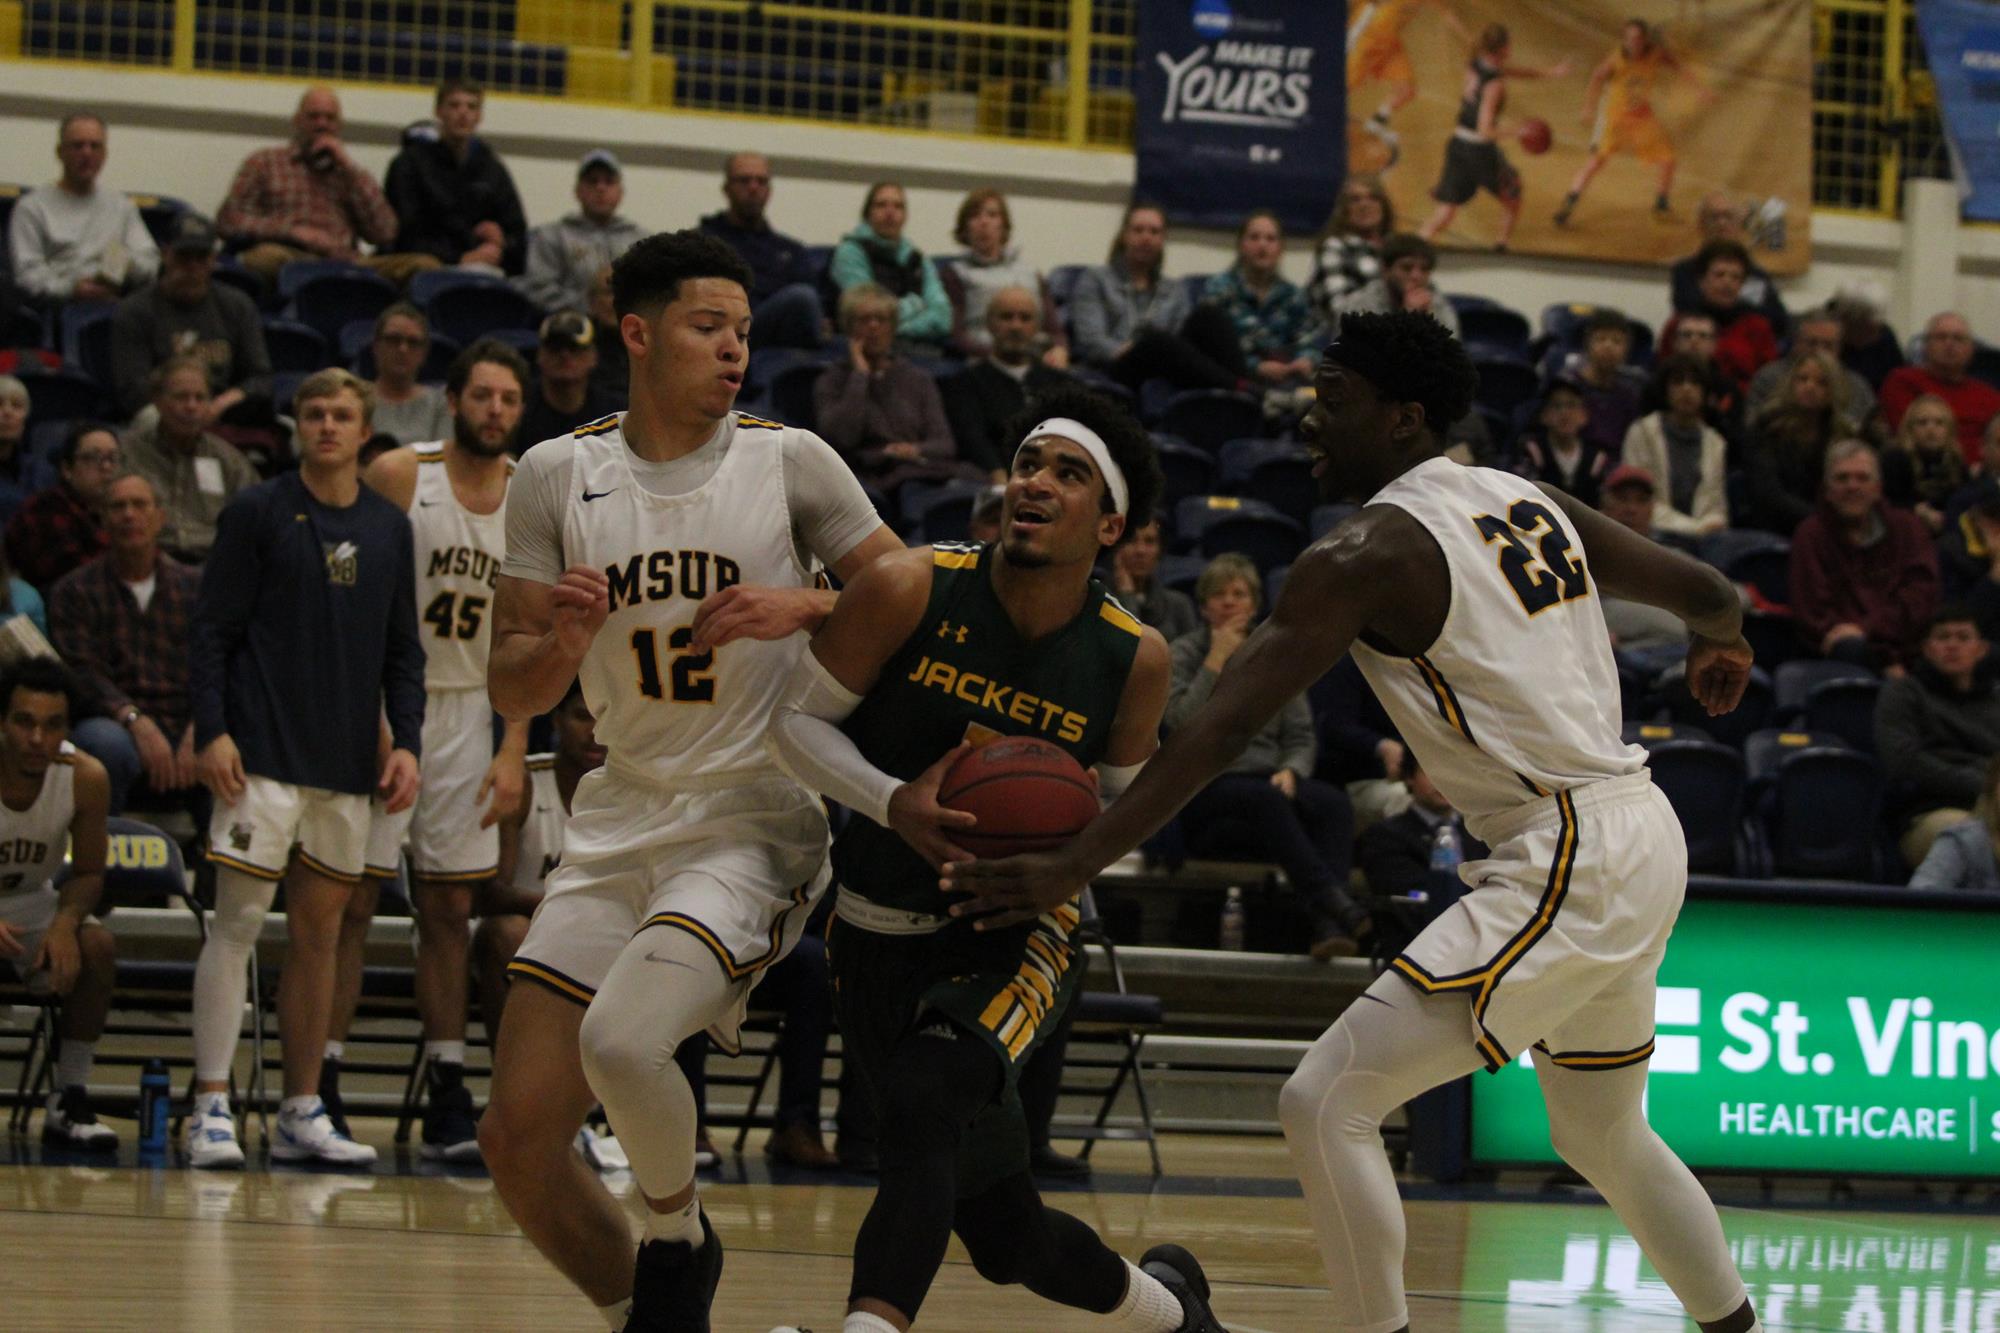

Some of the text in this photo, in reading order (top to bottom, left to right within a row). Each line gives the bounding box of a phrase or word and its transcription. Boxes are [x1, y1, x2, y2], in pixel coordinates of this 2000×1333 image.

[1156, 45, 1311, 122] YOURS
[1214, 40, 1314, 68] MAKE IT
[426, 546, 501, 590] MSUB
[1471, 498, 1591, 620] 22
[423, 589, 488, 640] 45
[630, 626, 717, 705] 12
[908, 655, 1089, 743] JACKETS
[1718, 991, 2000, 1080] St. Vin
[1719, 1101, 1958, 1141] HEALTHCARE
